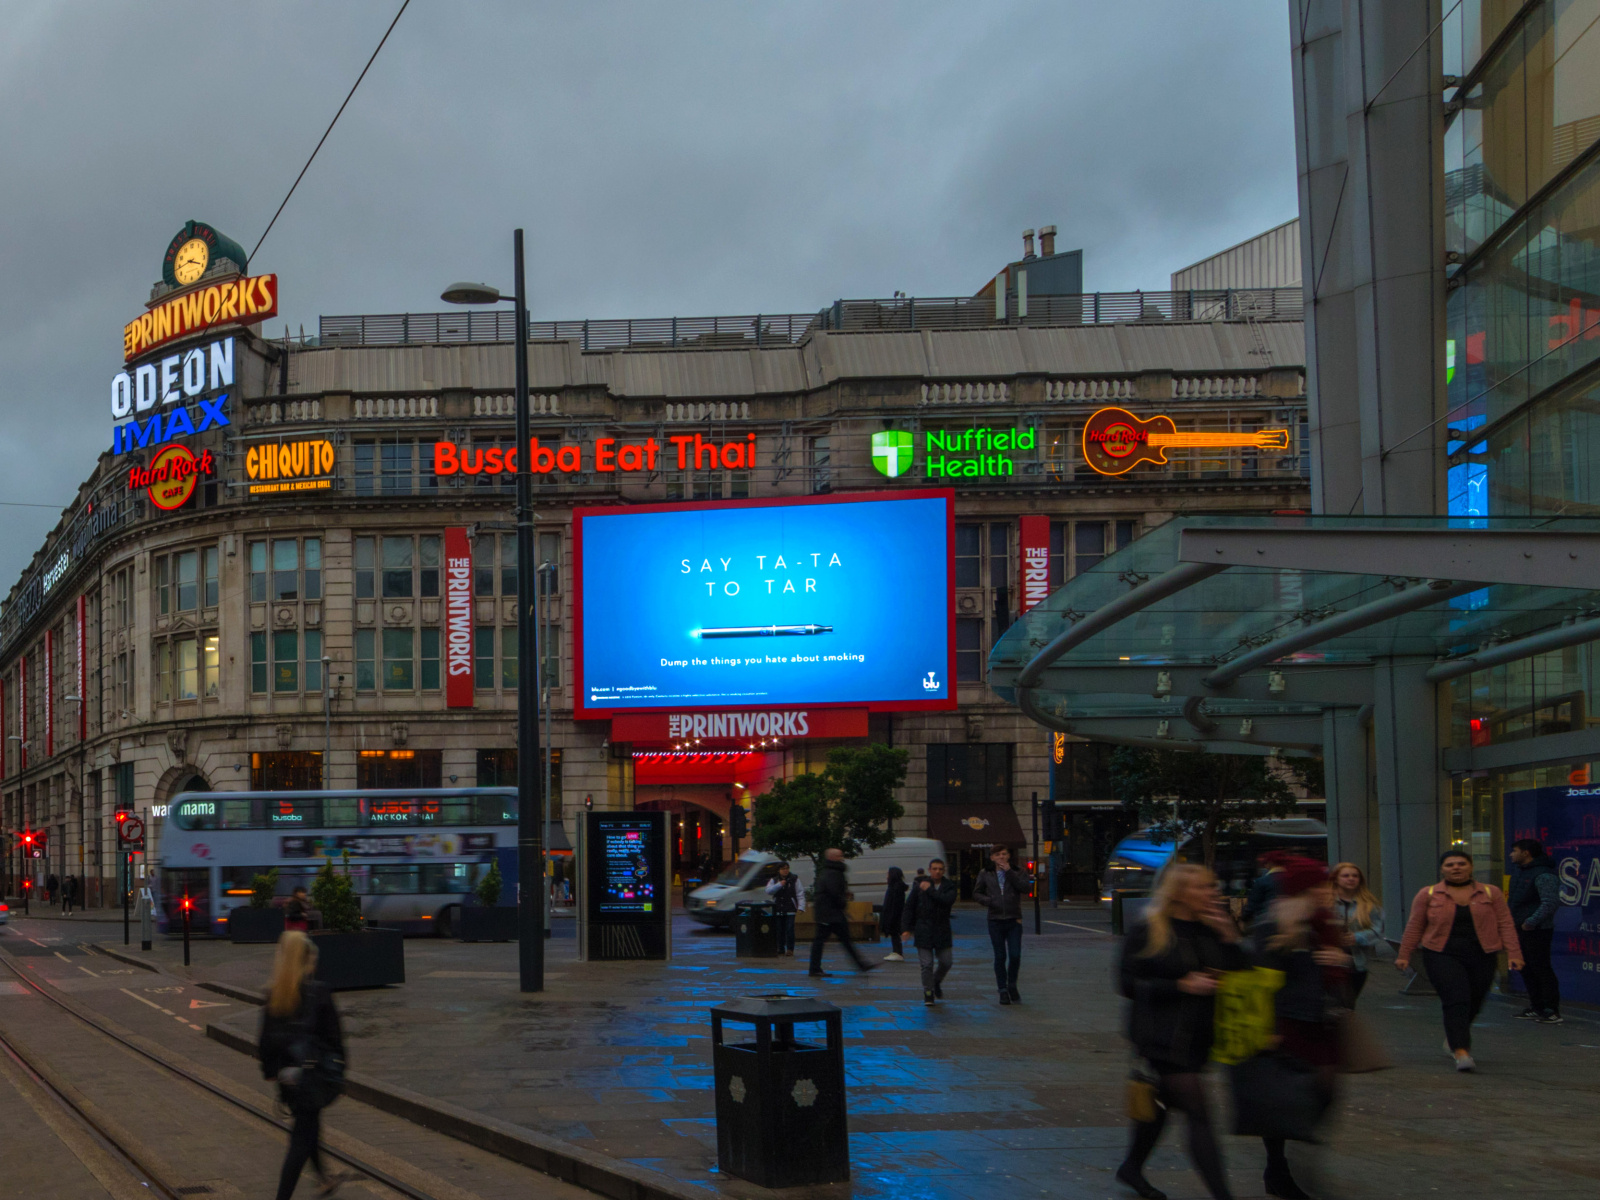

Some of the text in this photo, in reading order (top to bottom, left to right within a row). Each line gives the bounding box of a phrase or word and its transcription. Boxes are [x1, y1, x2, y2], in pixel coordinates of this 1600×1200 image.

[124, 274, 272, 362] THE PRINTWORKS
[111, 337, 235, 420] ODEON
[113, 394, 231, 456] IMAX
[926, 427, 1036, 452] Nuffield
[1090, 429, 1149, 444] Hard Rock
[246, 440, 335, 480] CHIQUITO
[434, 432, 756, 475] Busaba Eat Thai
[128, 449, 213, 489] Hard Rock
[926, 453, 1014, 477] Health
[162, 486, 183, 498] CAFE
[250, 480, 331, 494] RESTAURANT BAR & MEXICAN GRILL
[1025, 548, 1048, 557] THE
[681, 552, 842, 574] SAY TA-TA
[706, 578, 818, 597] TO TAR
[448, 558, 470, 676] THE PRINTWORKS
[660, 652, 865, 668] Dump the things you hate about smoking
[923, 671, 940, 689] blu
[669, 712, 809, 738] THE PRINTWORKS
[1515, 827, 1549, 842] HALF
[1580, 922, 1594, 932] ALL
[1569, 937, 1600, 956] HAL
[1582, 962, 1594, 971] OR
